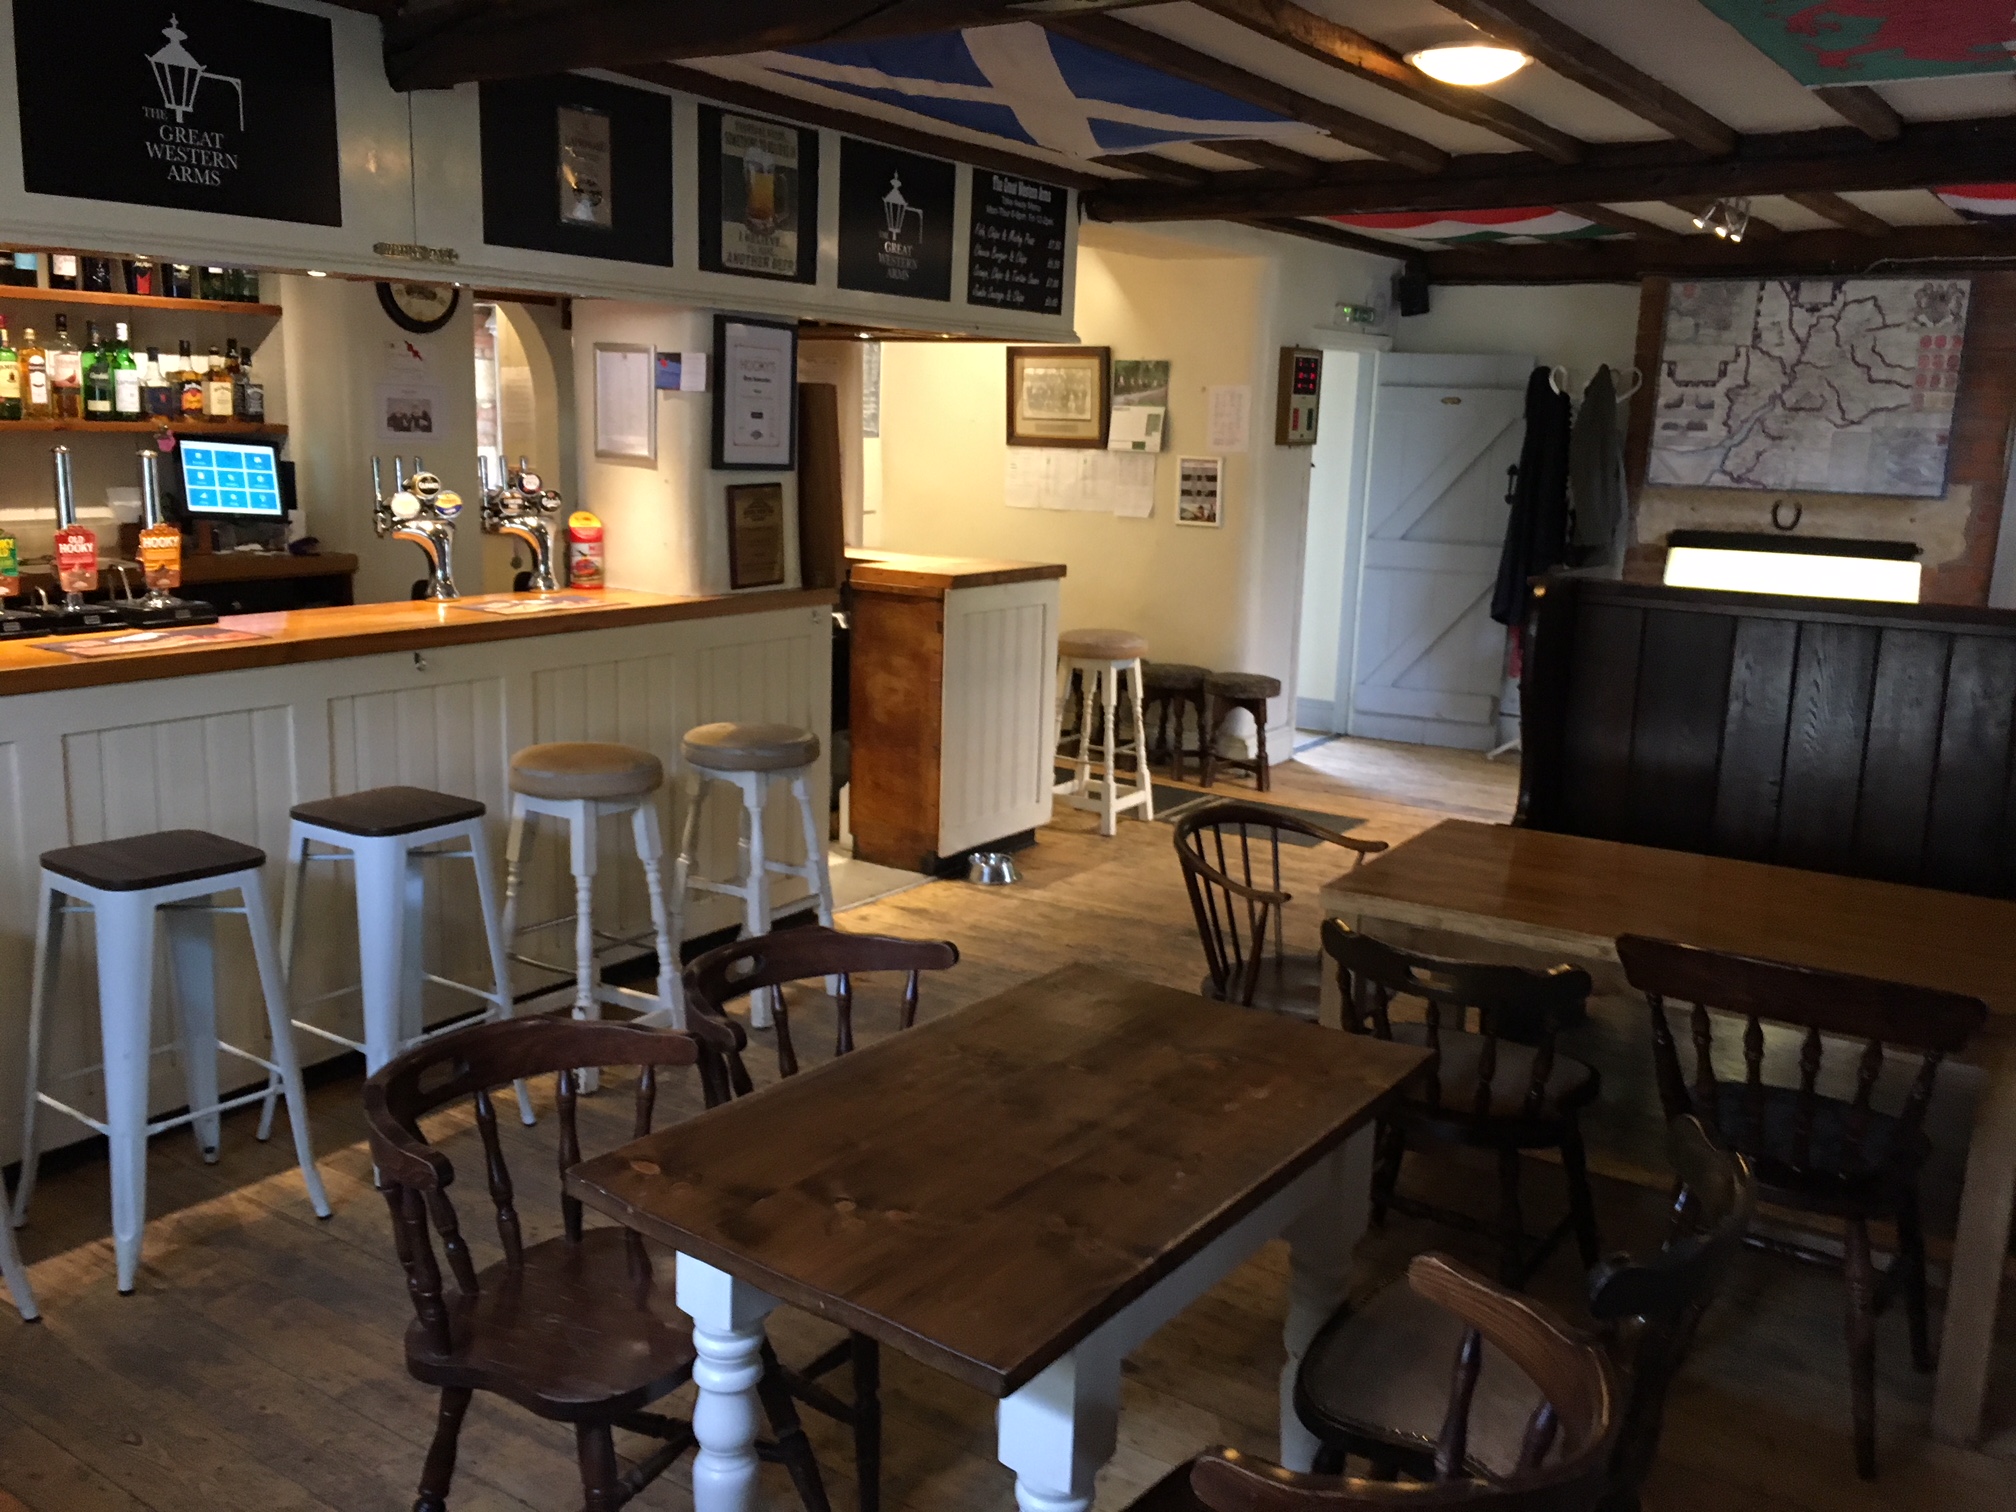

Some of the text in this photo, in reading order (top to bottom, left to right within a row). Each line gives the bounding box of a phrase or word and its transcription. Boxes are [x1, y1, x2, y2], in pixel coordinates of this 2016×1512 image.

[142, 106, 168, 120] THE
[160, 124, 225, 149] GREAT
[145, 141, 238, 170] WESTERN
[167, 165, 221, 187] ARMS
[884, 241, 912, 257] GREAT
[68, 535, 85, 544] OLD
[142, 536, 180, 548] HOOKY
[58, 543, 93, 554] HOOKY
